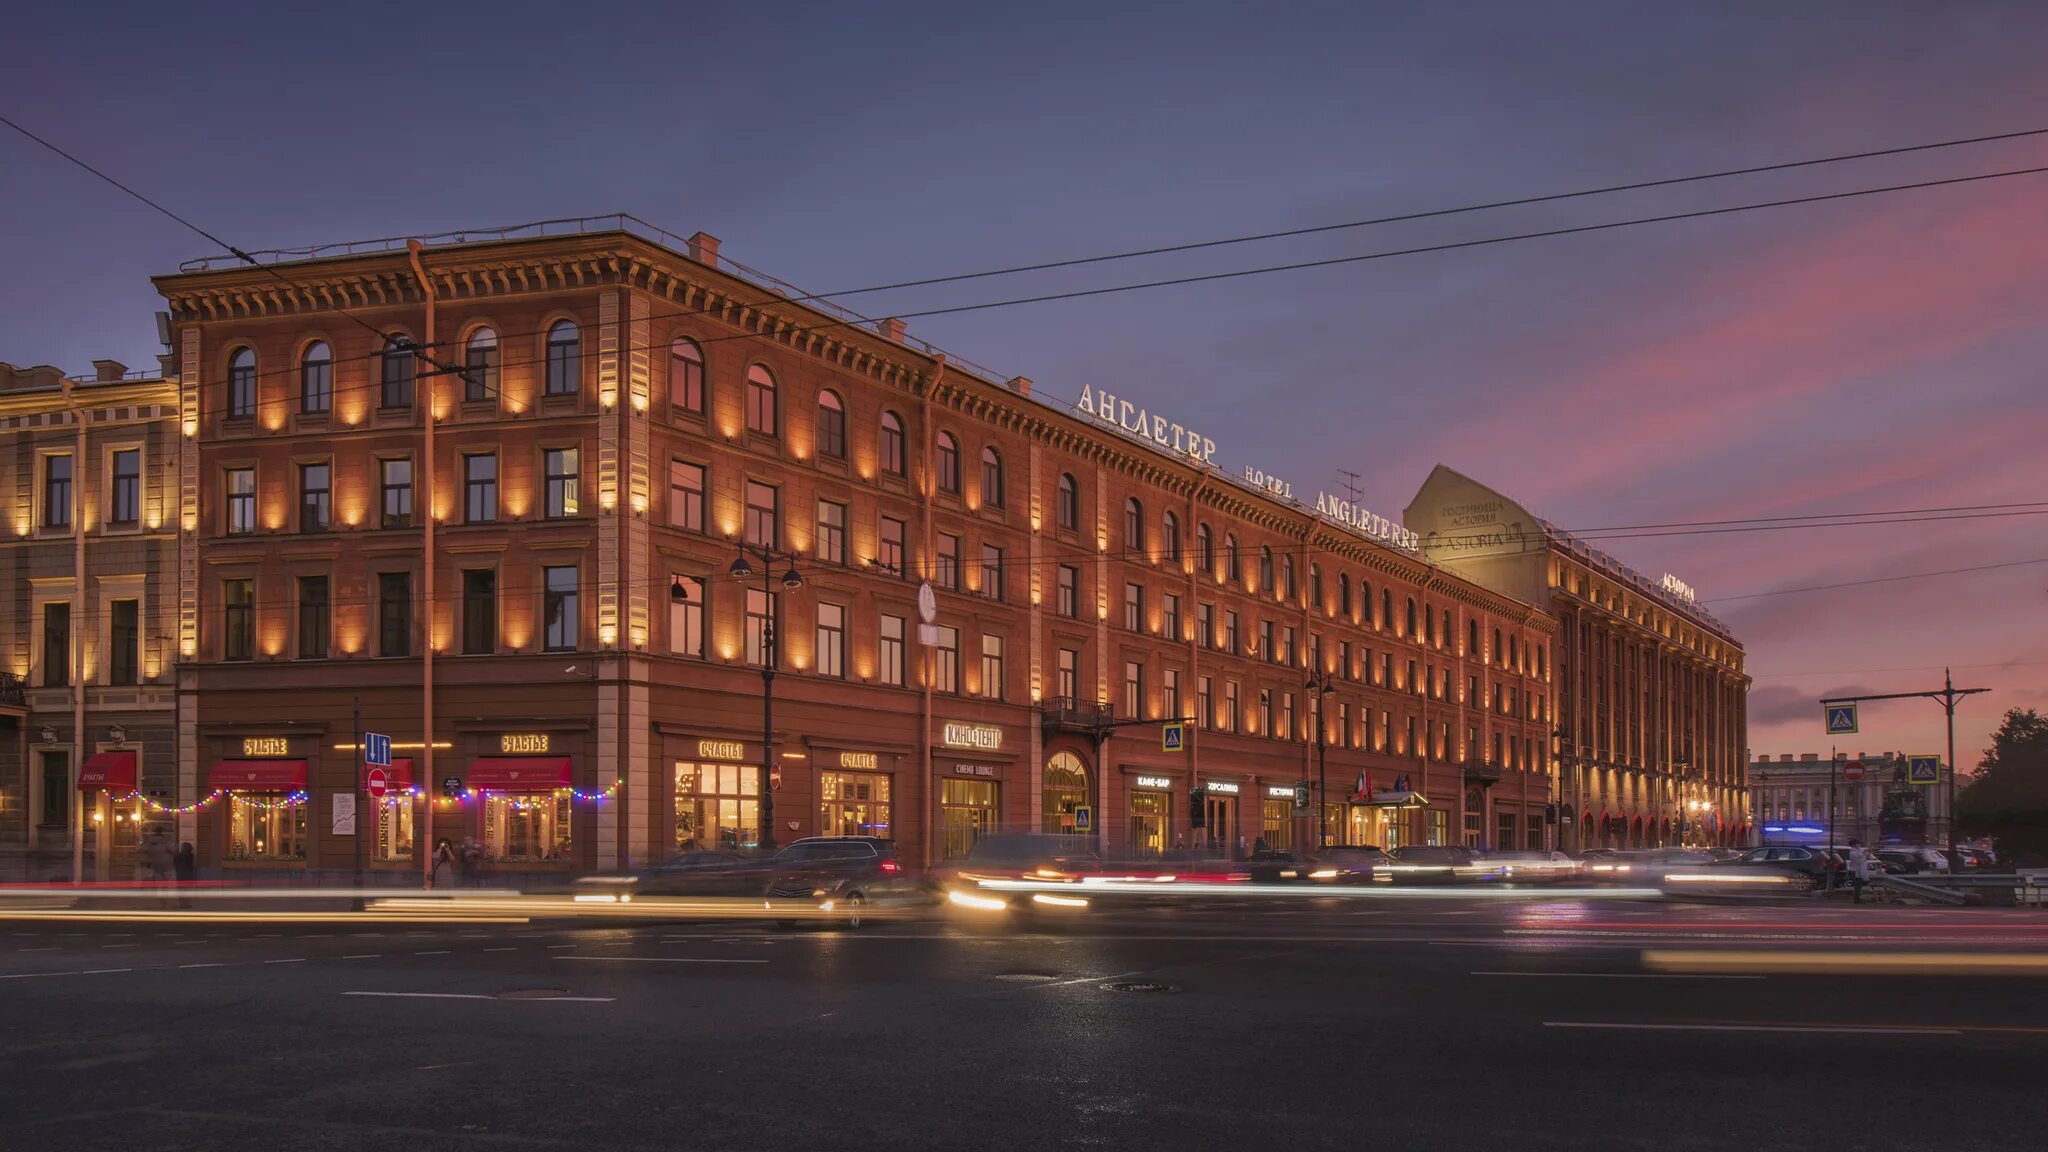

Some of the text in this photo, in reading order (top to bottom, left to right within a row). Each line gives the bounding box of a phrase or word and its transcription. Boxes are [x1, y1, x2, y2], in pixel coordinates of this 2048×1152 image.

[1078, 383, 1221, 468] АНГЛЕТЕР
[1245, 465, 1419, 551] HOTEL ANGLETERRE
[1442, 501, 1504, 517] ГОСТИНИЦА
[1451, 513, 1497, 527] АСТОРИЯ
[1444, 532, 1505, 552] ASTORIA
[243, 738, 288, 755] СЧАСТЬЕ
[502, 735, 548, 752] СЧАСТЬЕ
[699, 740, 744, 760] СЧАСТЬЕ
[840, 752, 879, 769] СЧАСТЬЕ
